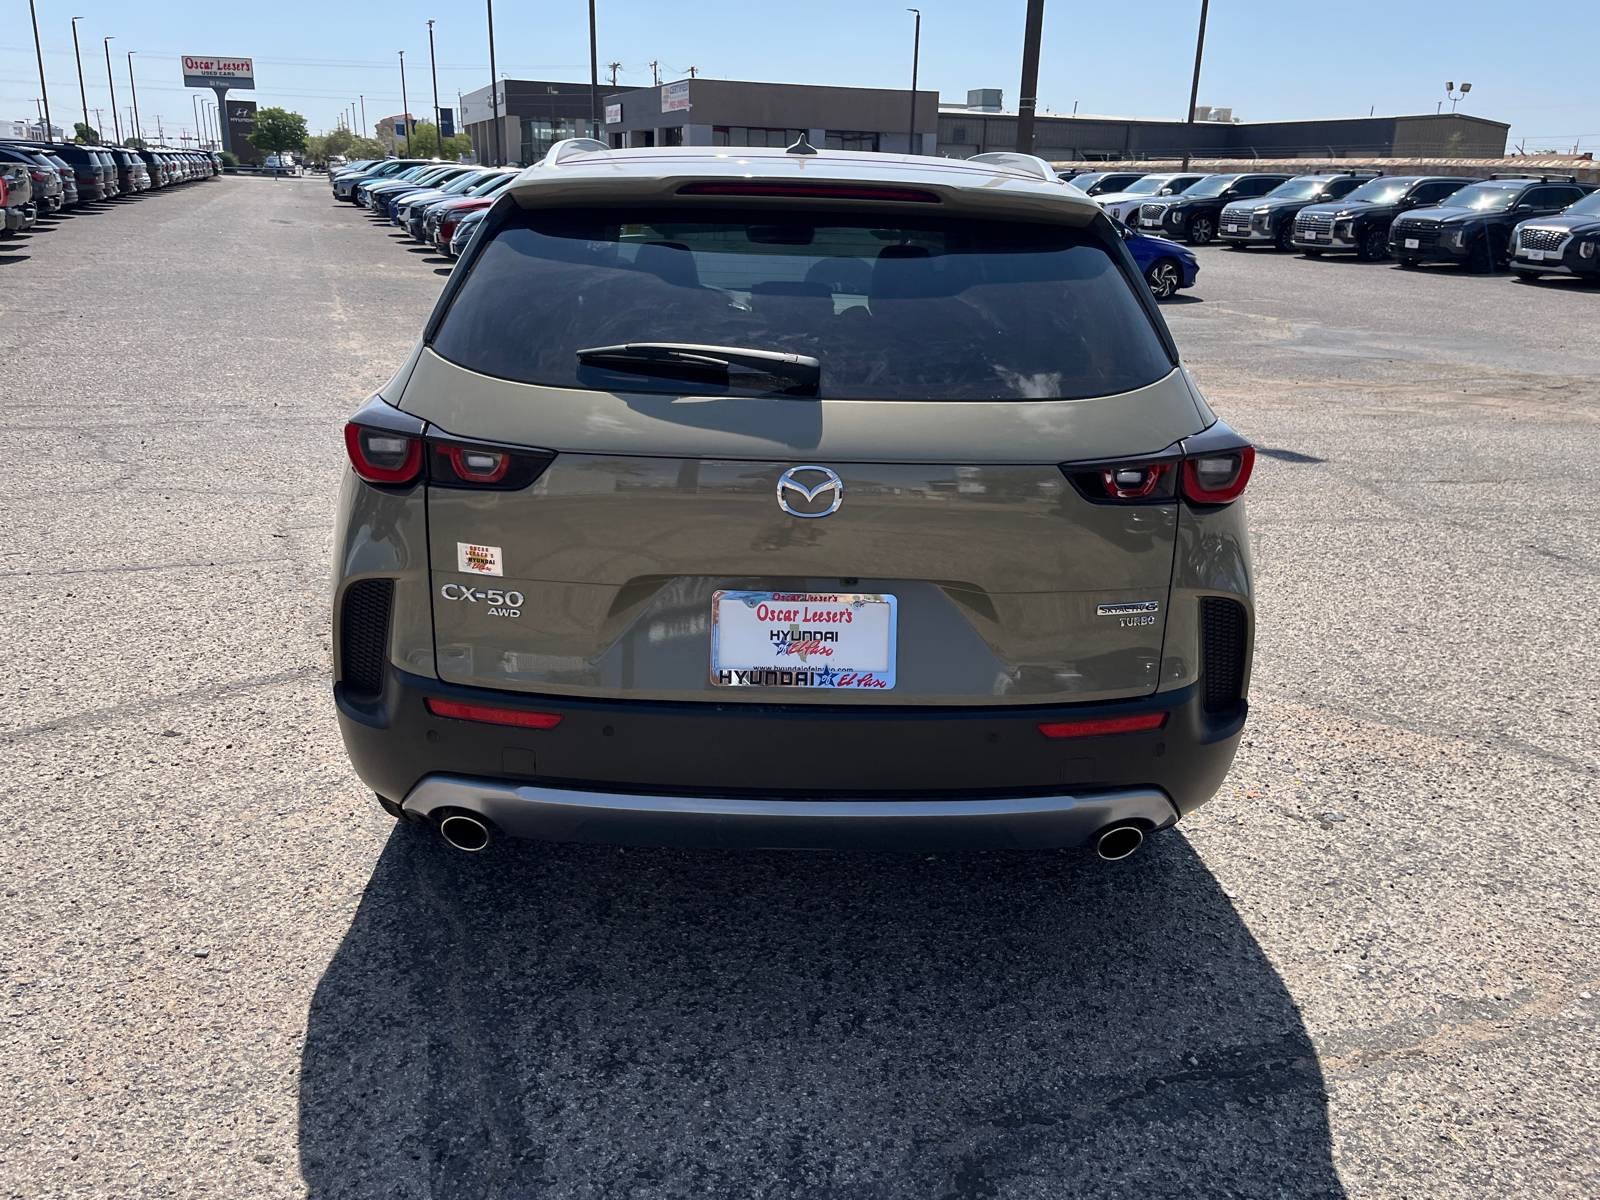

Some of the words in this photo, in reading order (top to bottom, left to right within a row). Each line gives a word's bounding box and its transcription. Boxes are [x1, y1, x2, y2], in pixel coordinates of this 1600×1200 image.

[185, 57, 214, 70] Oscar
[217, 59, 250, 71] Leeser's
[468, 557, 495, 565] HYUNDAI
[441, 583, 525, 607] CX-50
[772, 592, 801, 602] Oscar
[804, 593, 838, 602] Leeser's
[487, 607, 521, 618] AWD
[757, 603, 799, 622] Oscar
[802, 606, 853, 623] Leeser's
[1119, 615, 1155, 627] TURBO
[770, 630, 839, 642] HYUNDAI
[777, 641, 790, 656] of
[788, 640, 810, 655] El
[804, 639, 834, 657] Paso
[753, 664, 854, 672] wwwhyundaiofelpocom
[719, 669, 814, 686] HYUNDAI
[821, 673, 833, 685] of
[837, 672, 858, 688] El
[857, 672, 887, 688] Paso
